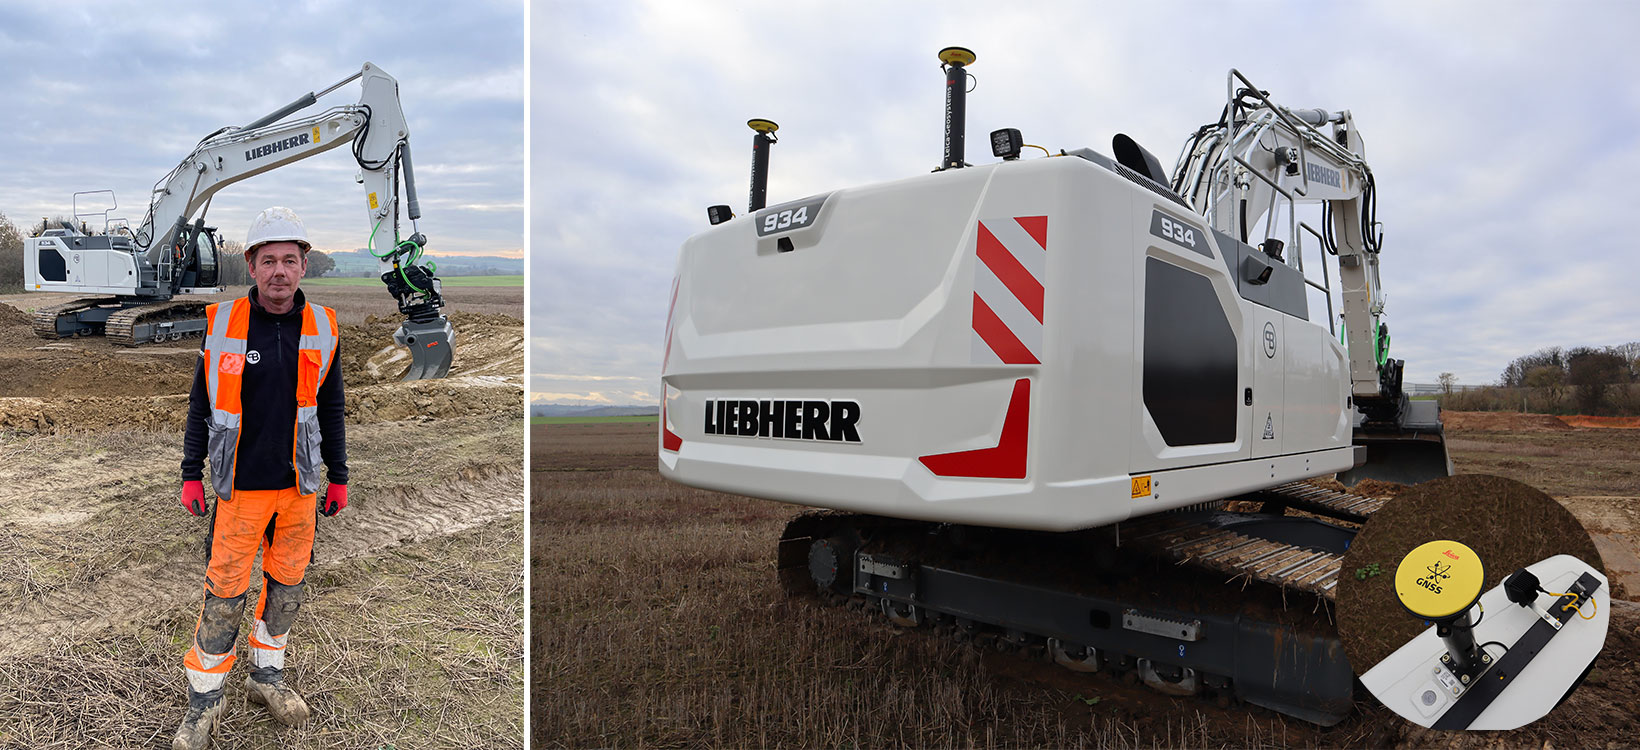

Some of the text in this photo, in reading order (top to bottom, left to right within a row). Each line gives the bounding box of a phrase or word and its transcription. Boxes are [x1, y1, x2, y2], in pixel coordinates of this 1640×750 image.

[245, 132, 310, 162] LIEBHERR
[1307, 162, 1341, 189] IEBHERR
[763, 206, 808, 232] 934
[1161, 217, 1196, 248] 934
[704, 400, 862, 443] LIEBHERR
[1441, 549, 1460, 560] Leica
[1416, 577, 1443, 594] GNSS
